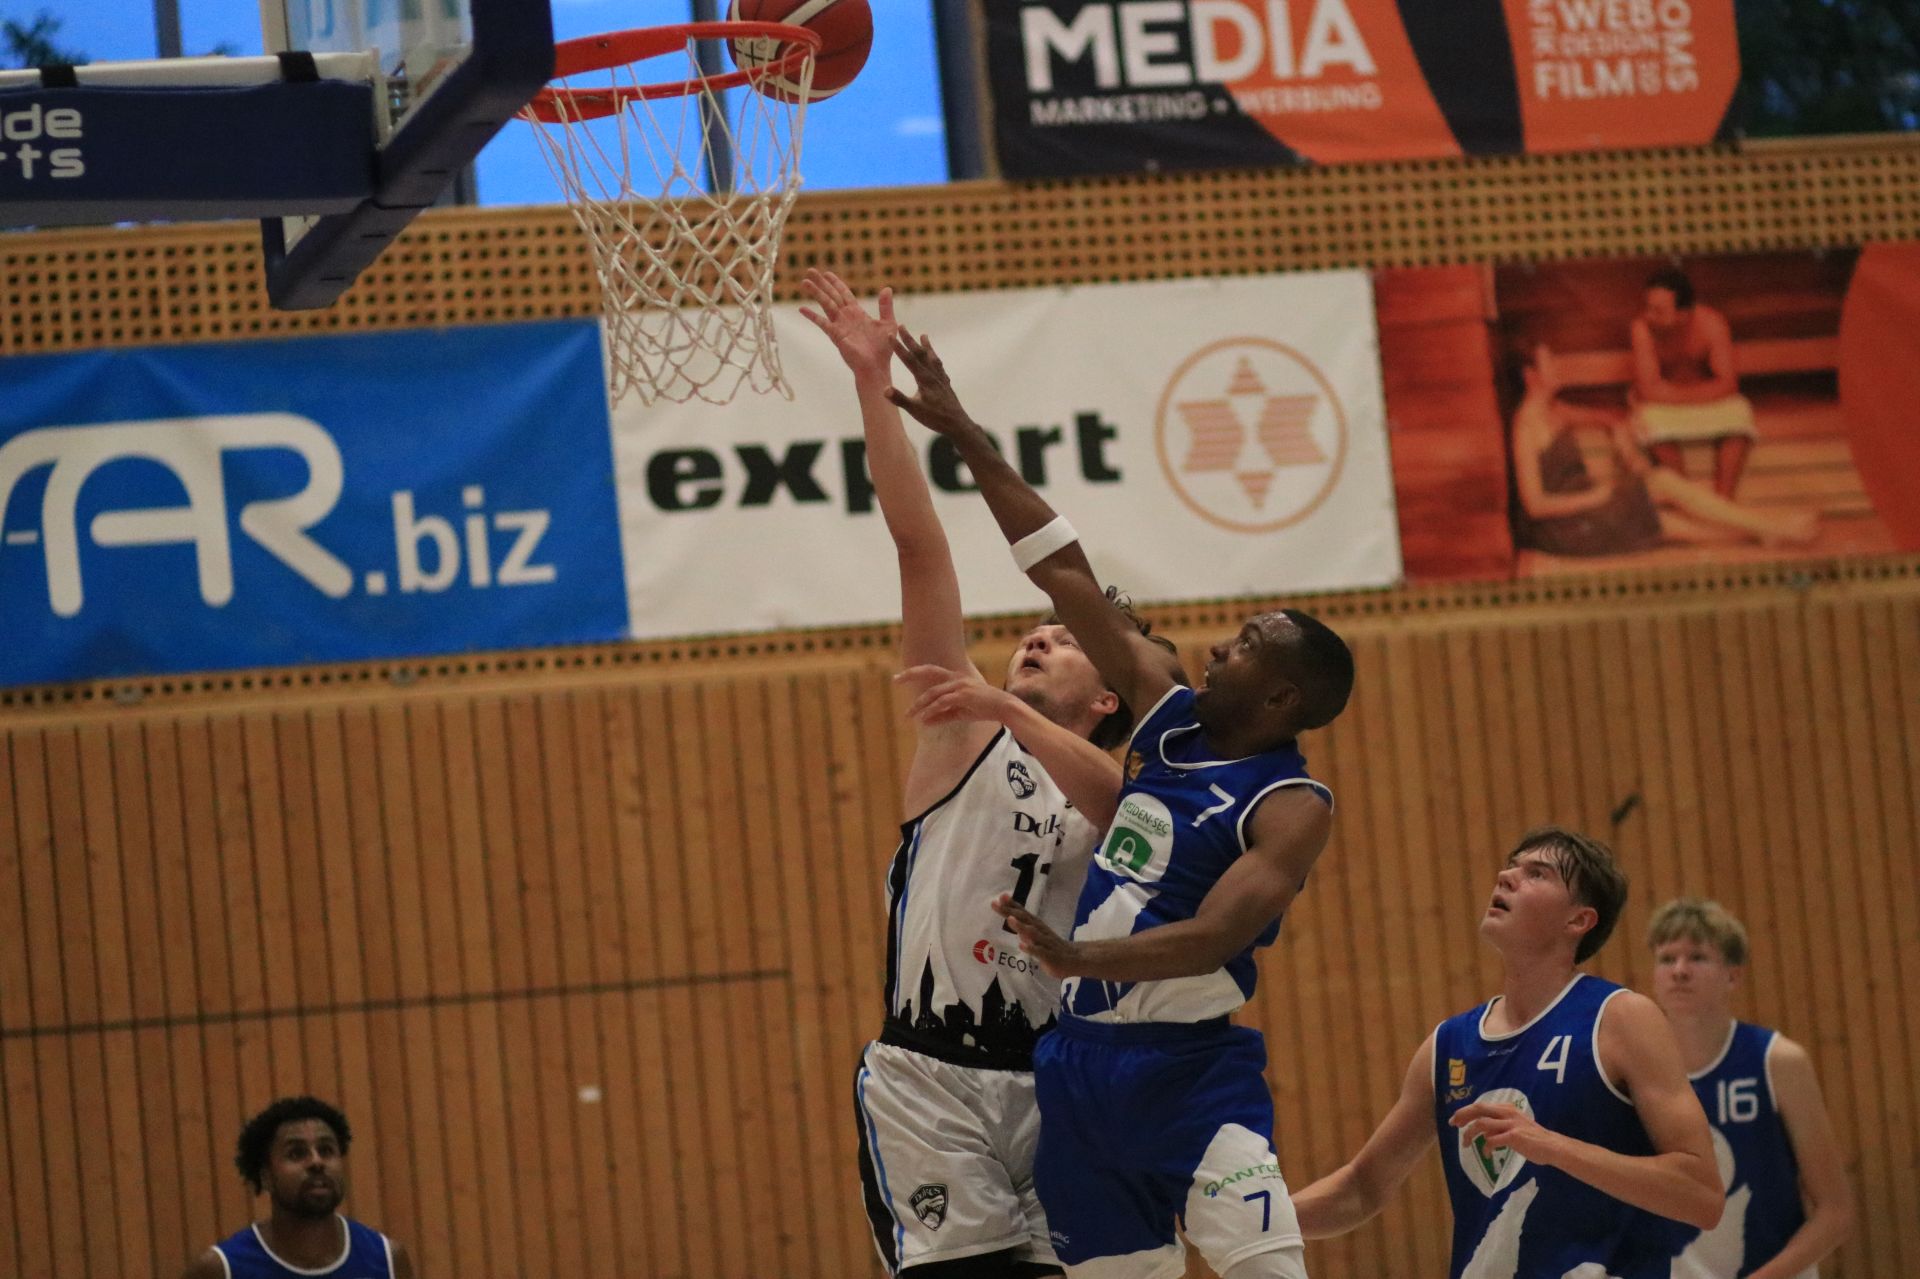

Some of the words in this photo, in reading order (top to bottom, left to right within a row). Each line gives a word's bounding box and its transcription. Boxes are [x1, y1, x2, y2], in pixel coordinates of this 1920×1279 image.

[1558, 0, 1656, 31] WEB
[1019, 0, 1378, 93] MEDIA
[1535, 59, 1635, 98] FILM
[0, 103, 83, 140] de
[1029, 92, 1207, 126] MARKETING
[1236, 83, 1382, 116] WERBUNG
[1192, 783, 1236, 828] 7
[1537, 1035, 1573, 1084] 4
[1717, 1078, 1759, 1124] 16
[1243, 1190, 1271, 1232] 7
